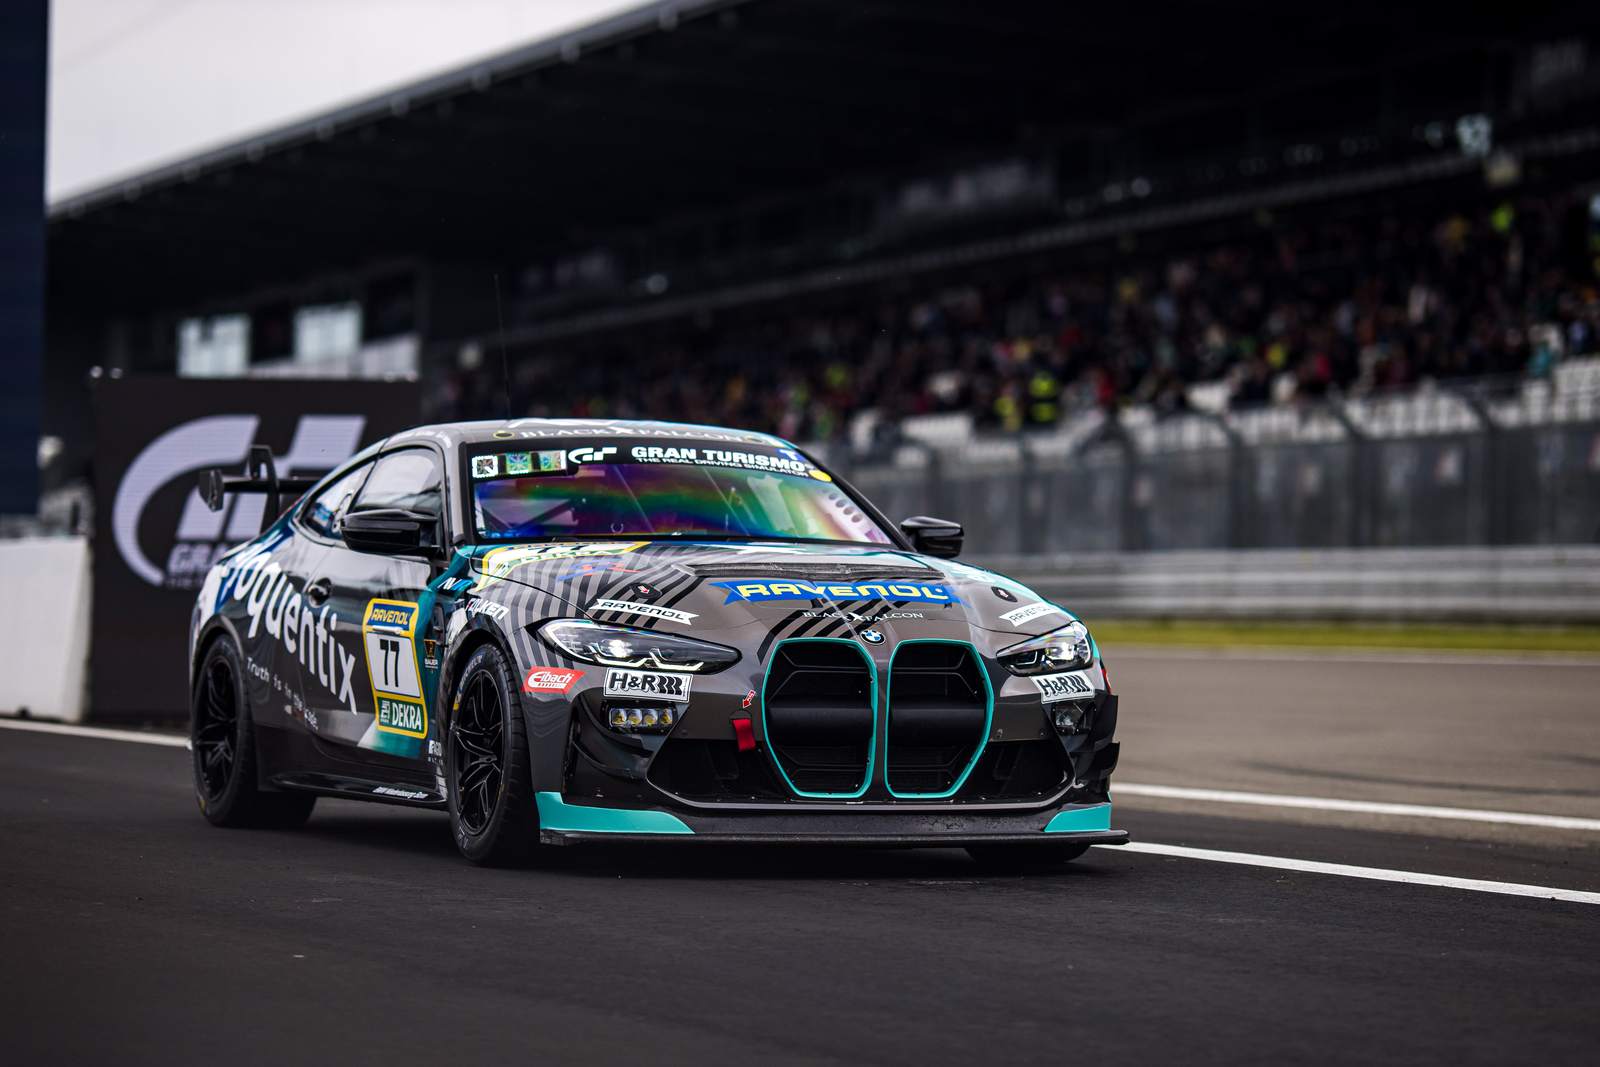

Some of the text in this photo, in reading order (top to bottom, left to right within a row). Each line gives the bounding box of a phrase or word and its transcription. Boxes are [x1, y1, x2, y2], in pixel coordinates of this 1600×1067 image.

[631, 446, 807, 473] GRAN TURISMO
[662, 457, 694, 466] REAL
[694, 459, 743, 469] DRIVING
[743, 463, 809, 478] SIMULATOR
[736, 583, 948, 600] RAVENOL
[371, 607, 410, 626] RAVENOL
[600, 601, 685, 621] RAVENOL
[247, 656, 270, 683] Truth
[379, 638, 400, 688] 77
[527, 671, 575, 689] Eibach
[609, 671, 658, 693] H&R
[1036, 673, 1075, 698] H&R
[391, 701, 422, 731] DEKRA
